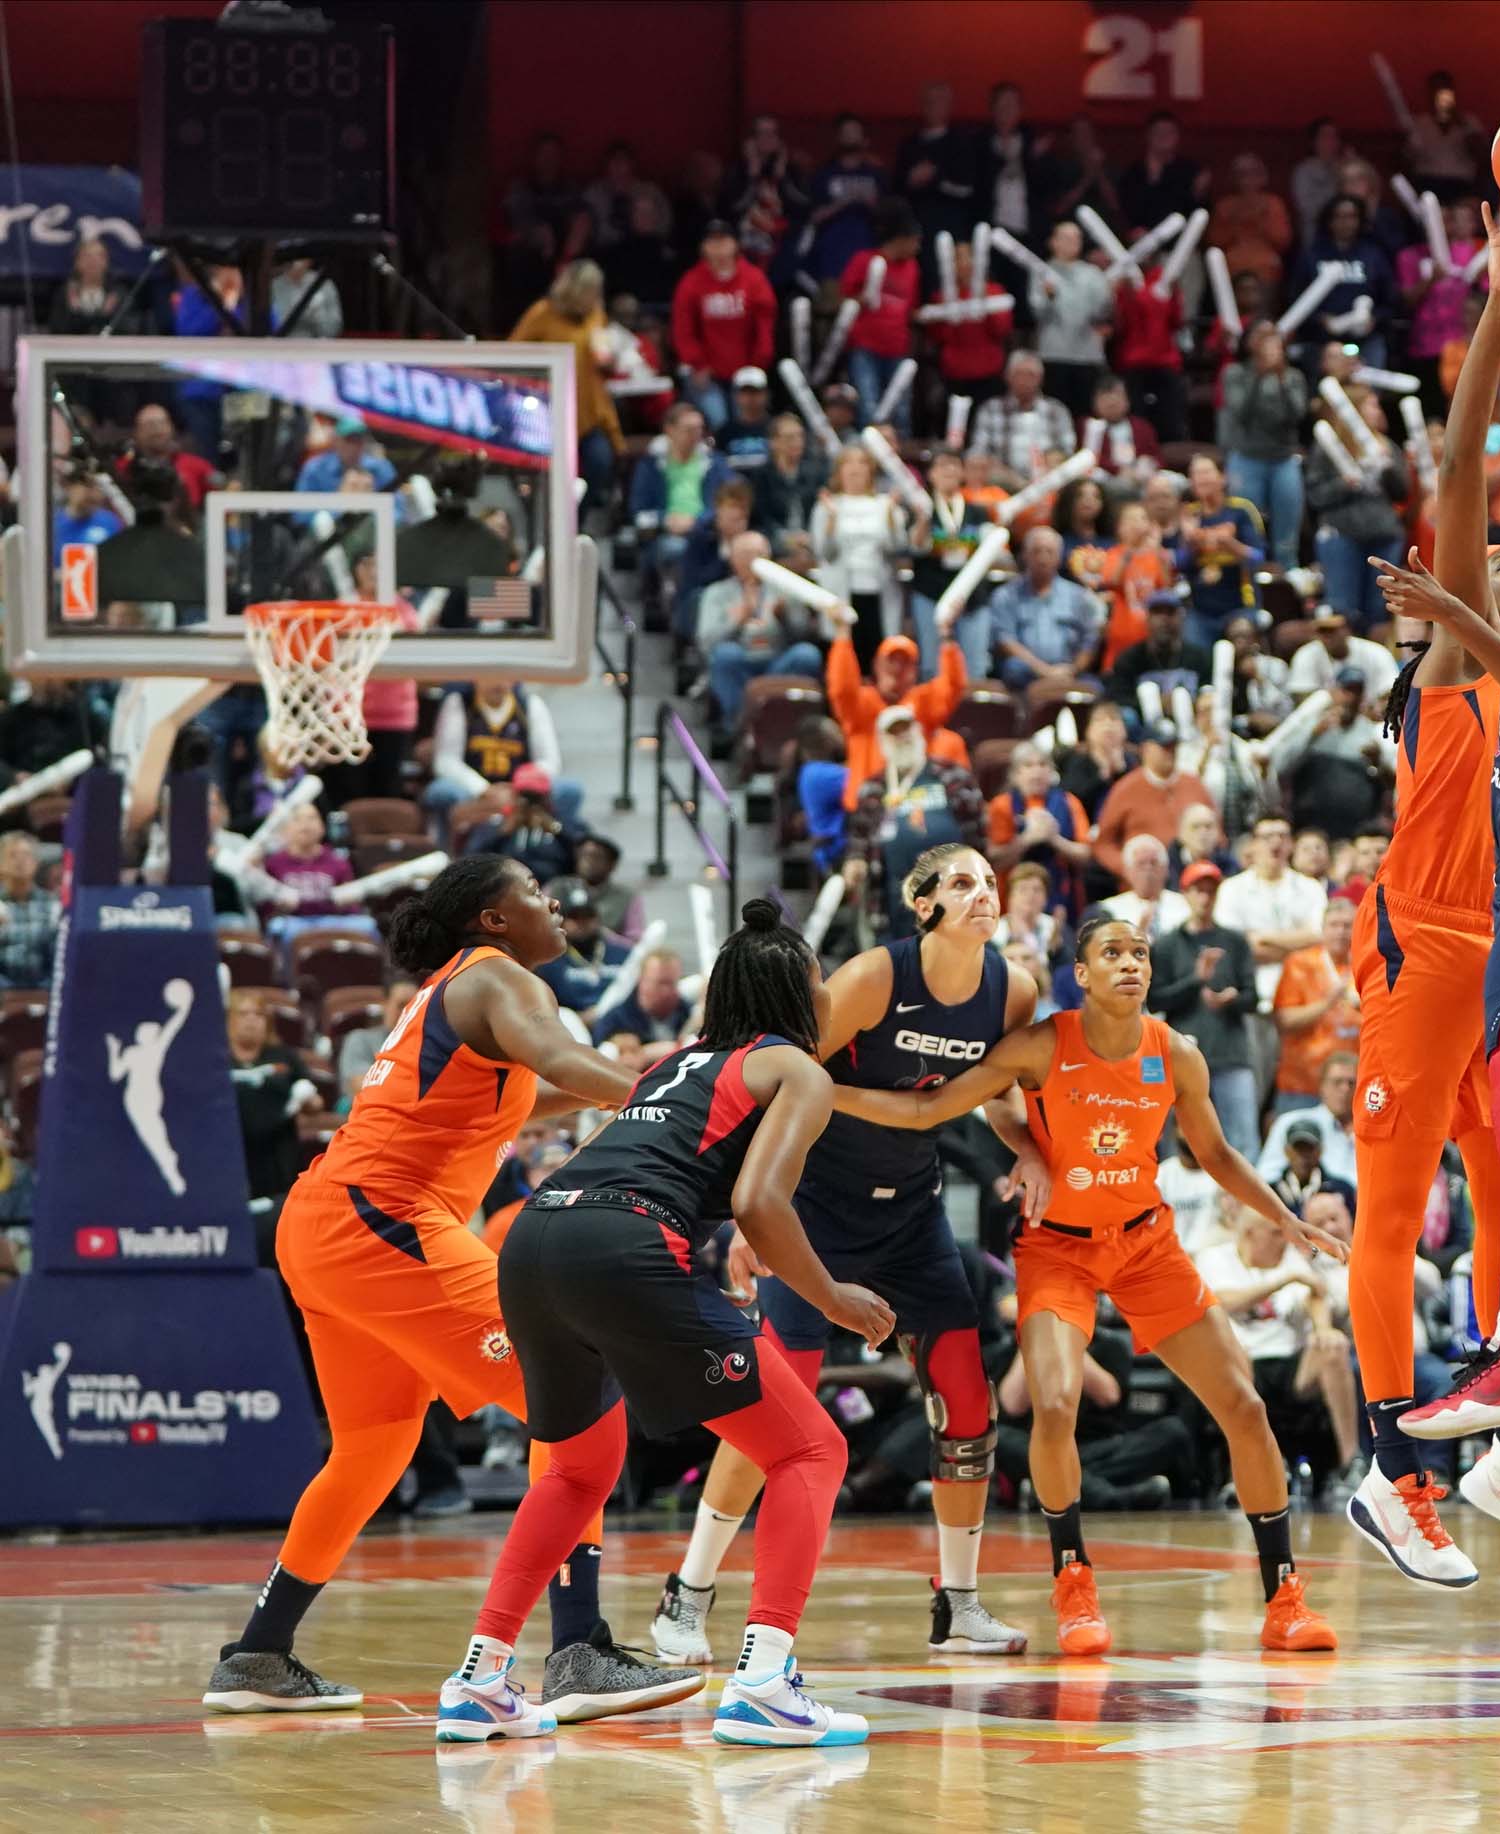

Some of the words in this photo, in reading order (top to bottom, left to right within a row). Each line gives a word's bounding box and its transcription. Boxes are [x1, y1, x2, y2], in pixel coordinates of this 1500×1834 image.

[1083, 15, 1204, 97] 21
[895, 1029, 986, 1060] GEICO
[645, 1052, 714, 1101] 7
[1096, 1167, 1139, 1186] AT&T
